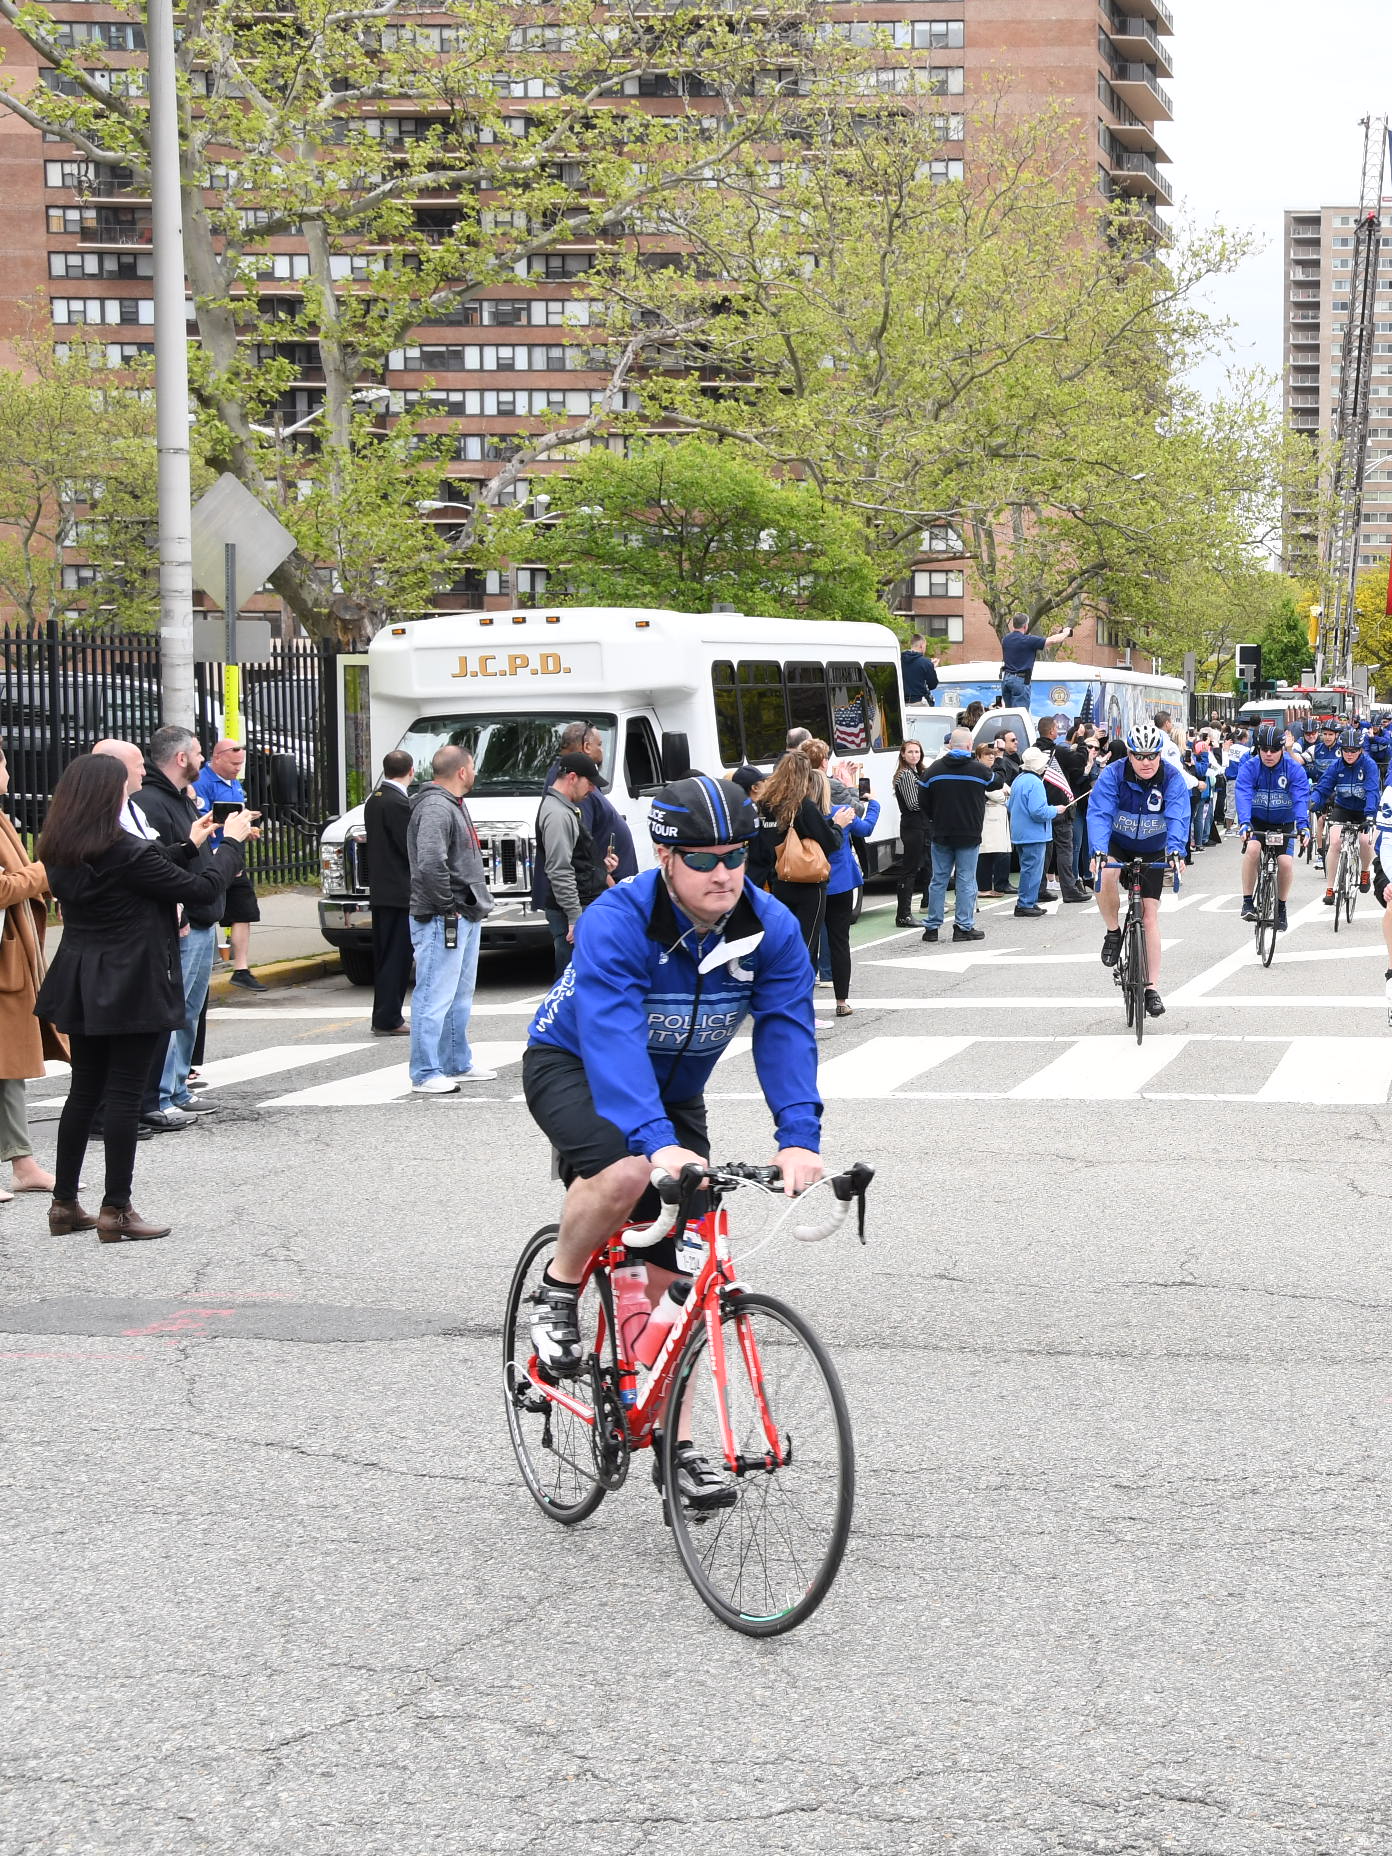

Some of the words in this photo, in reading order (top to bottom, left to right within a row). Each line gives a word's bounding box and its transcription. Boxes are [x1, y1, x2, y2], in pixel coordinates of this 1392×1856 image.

[451, 652, 572, 678] J.C.P.D.
[648, 808, 667, 822] ICE
[1118, 815, 1160, 828] POLICE
[651, 821, 679, 838] TOUR
[647, 1011, 739, 1029] POLICE
[648, 1030, 690, 1044] ITY
[698, 1028, 736, 1043] TOU
